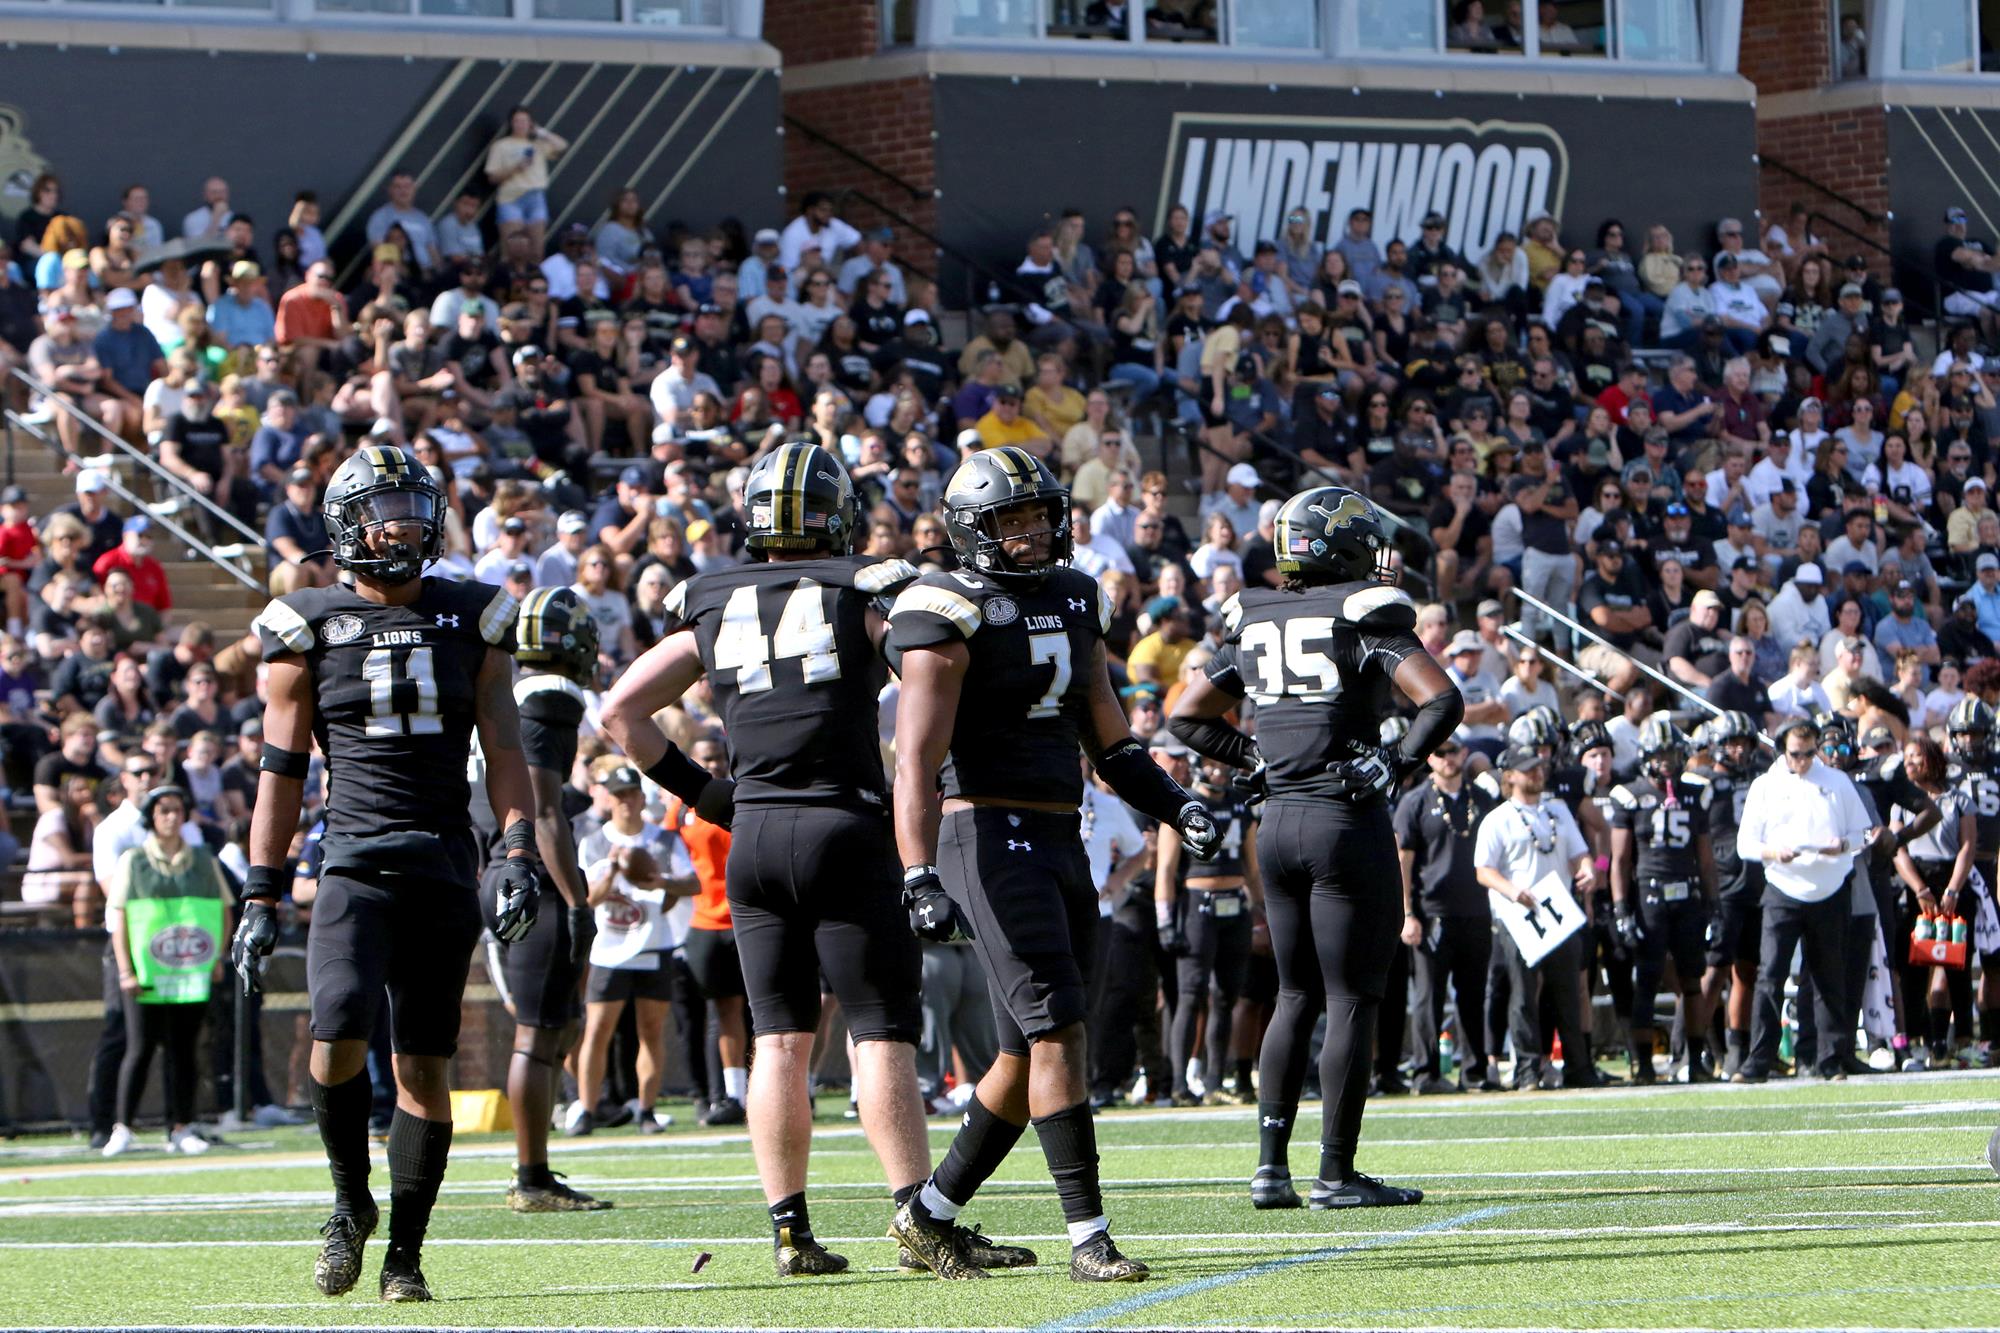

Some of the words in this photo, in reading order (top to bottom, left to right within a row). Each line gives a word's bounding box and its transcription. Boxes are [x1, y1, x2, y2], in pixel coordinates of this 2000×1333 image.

[1171, 137, 1552, 267] LINDENWOOD
[372, 630, 423, 647] LIONS
[713, 577, 842, 695] 44
[1024, 615, 1064, 630] LIONS
[1240, 617, 1344, 706] 35
[362, 646, 444, 737] 11
[1026, 631, 1073, 719] 7
[1650, 809, 1691, 848] 15
[1932, 944, 1947, 960] G
